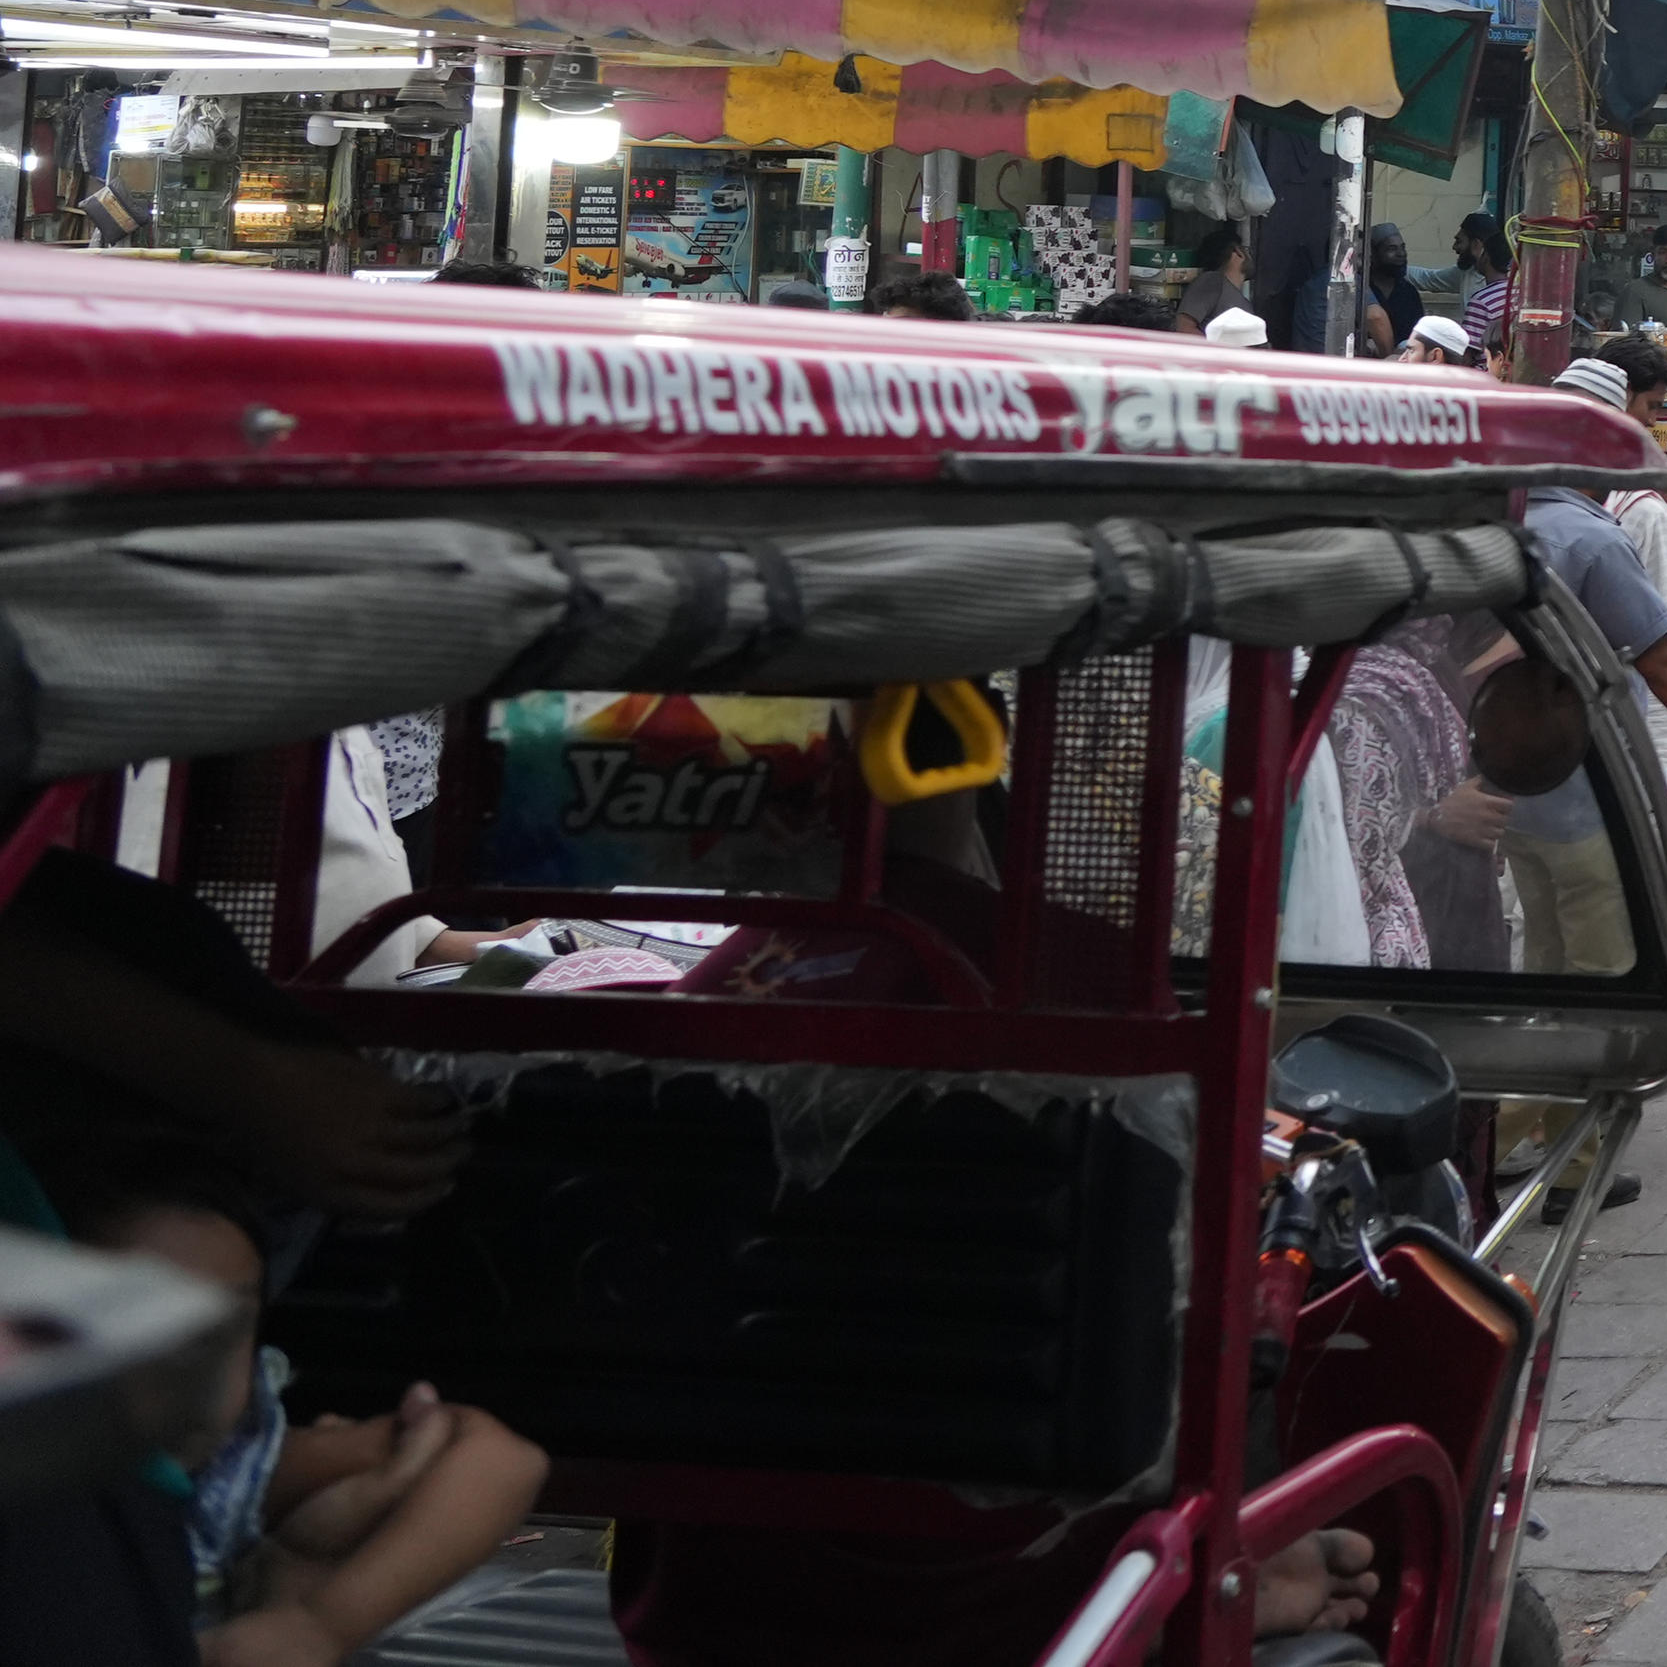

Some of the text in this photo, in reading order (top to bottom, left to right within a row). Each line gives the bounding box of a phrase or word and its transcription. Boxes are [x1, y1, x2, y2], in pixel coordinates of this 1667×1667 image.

[591, 196, 617, 204] TICKETS
[580, 206, 610, 214] DOMESTIC
[576, 237, 616, 245] RESERVATION
[496, 342, 828, 436] WADHERA
[824, 358, 1042, 442] MOTORS
[566, 746, 768, 828] Yatri
